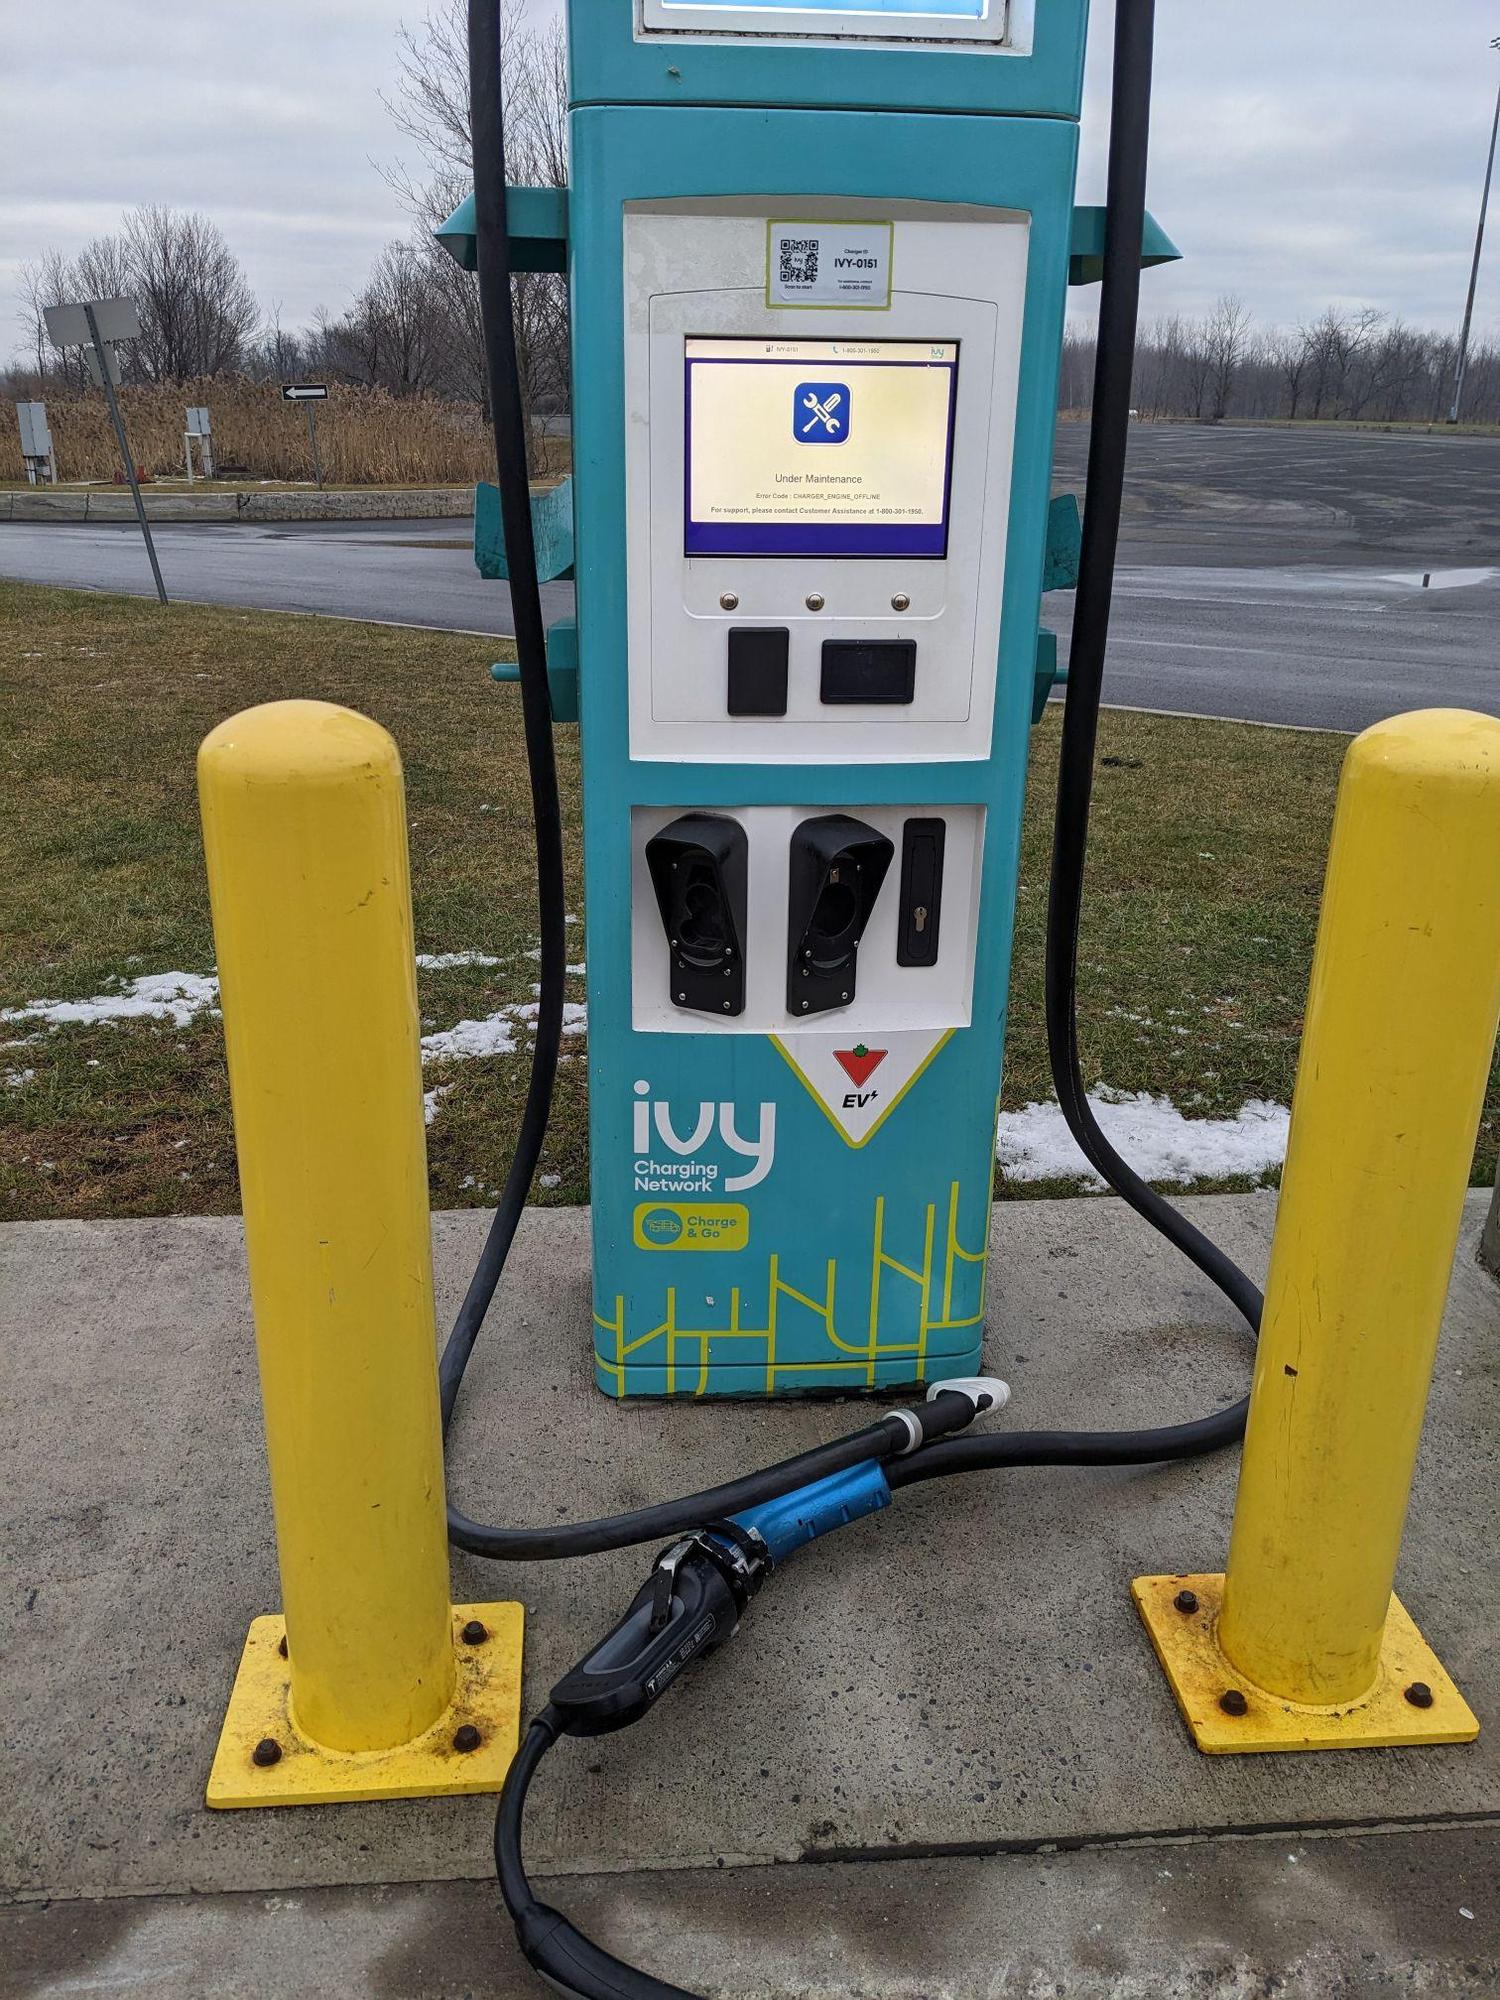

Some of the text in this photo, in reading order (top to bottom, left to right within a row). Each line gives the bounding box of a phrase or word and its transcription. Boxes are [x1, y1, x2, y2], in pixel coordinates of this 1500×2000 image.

[834, 258, 878, 268] IVY-0151
[930, 346, 944, 359] ivy
[775, 473, 863, 484] Under Maintenance
[793, 493, 881, 501] CHARGER_ENGINE_OFFLINE
[842, 1094, 871, 1108] EV
[633, 1079, 776, 1192] ivy
[634, 1160, 718, 1179] Charging
[634, 1177, 712, 1192] Network
[687, 1216, 737, 1229] Charge
[687, 1228, 720, 1238] & Go
